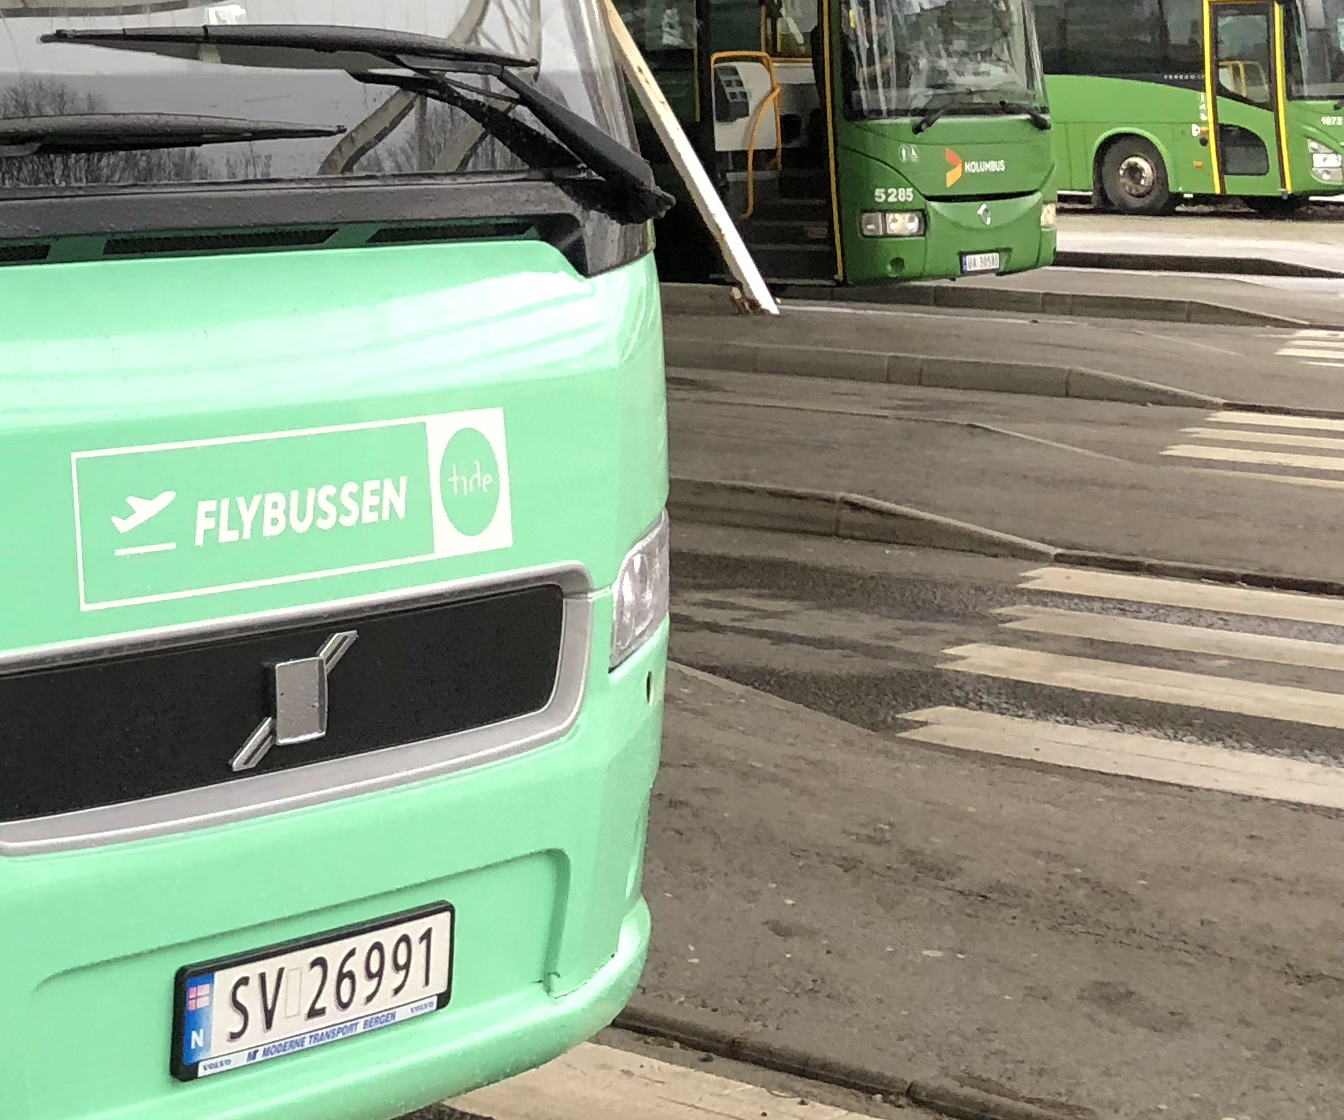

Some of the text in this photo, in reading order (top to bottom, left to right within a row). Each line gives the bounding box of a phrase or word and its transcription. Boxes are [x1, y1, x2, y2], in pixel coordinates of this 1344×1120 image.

[964, 160, 1006, 173] KOLUMBUS
[448, 460, 494, 497] tide
[194, 476, 409, 547] FLYBUSSEN
[227, 927, 434, 1043] SV 26991
[191, 1029, 204, 1050] N
[203, 1058, 232, 1072] VOLVO
[262, 1036, 306, 1058] MODERNE
[308, 1022, 360, 1046] TRANSPORT
[363, 1010, 396, 1030] BERGEN
